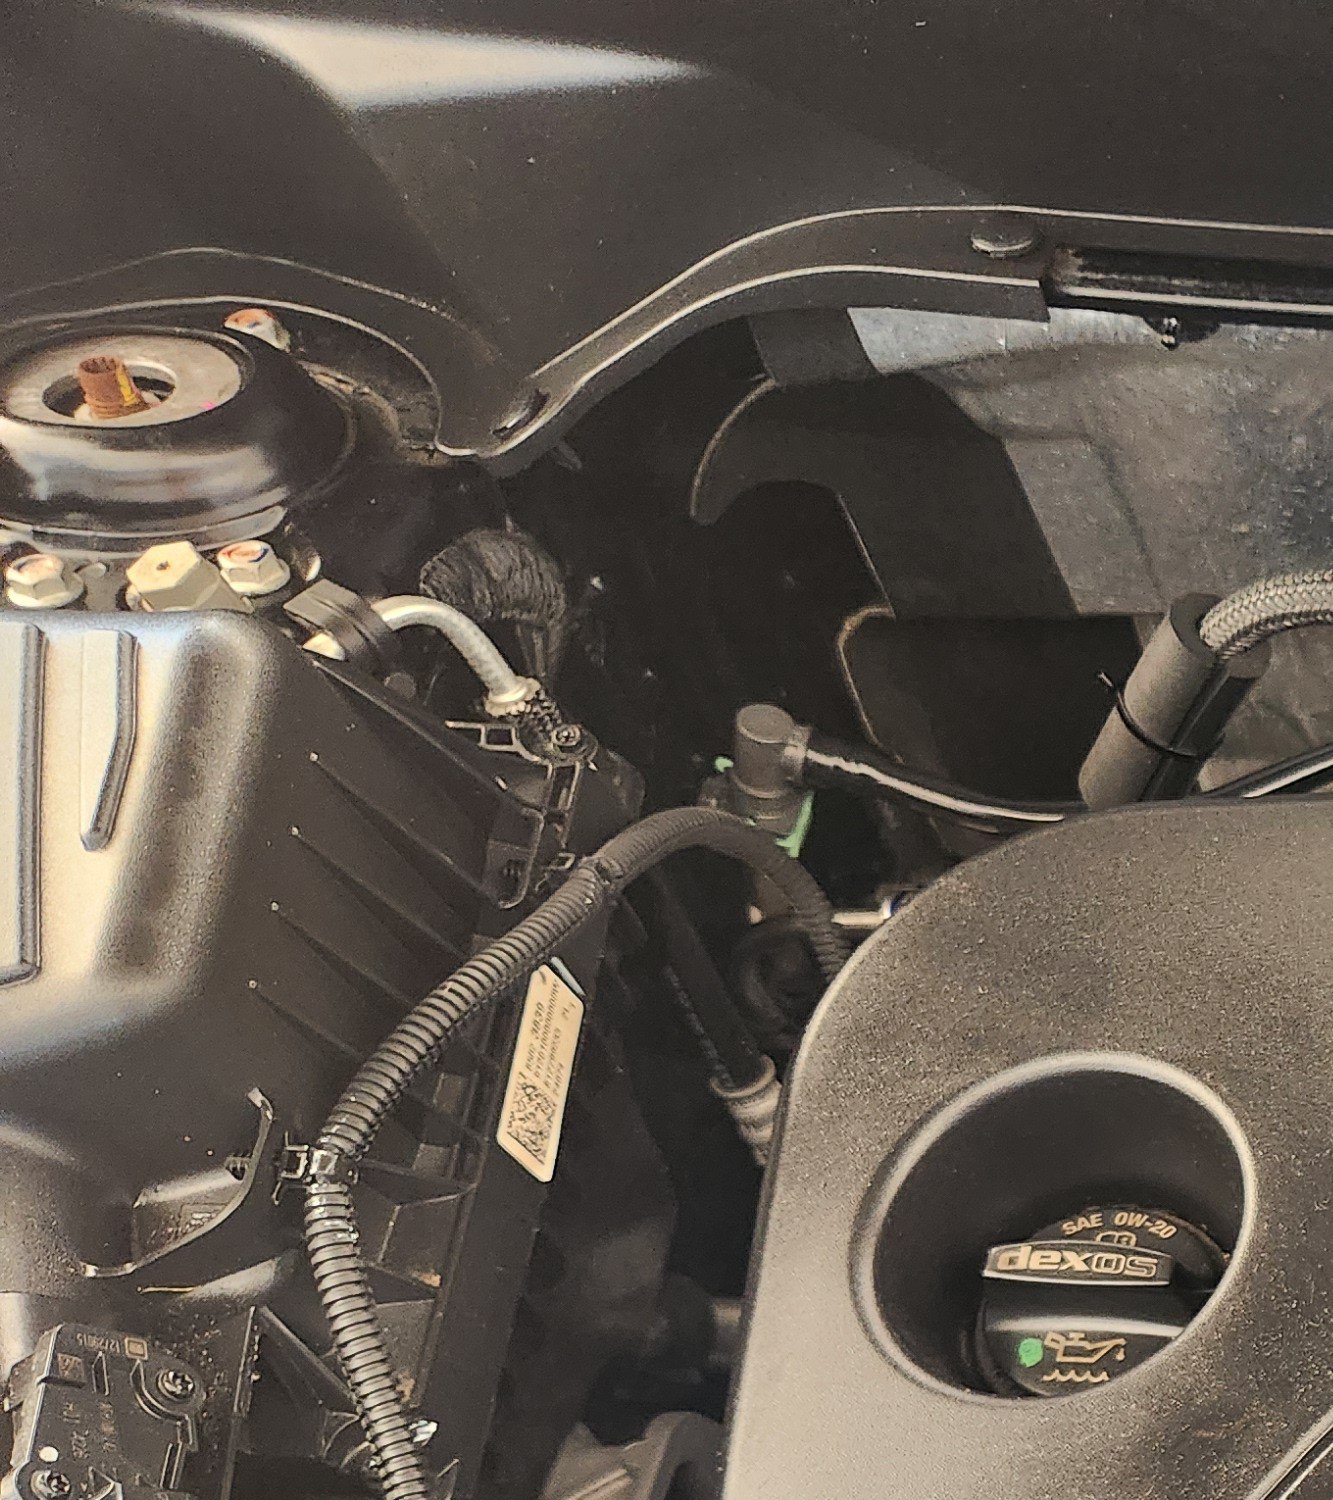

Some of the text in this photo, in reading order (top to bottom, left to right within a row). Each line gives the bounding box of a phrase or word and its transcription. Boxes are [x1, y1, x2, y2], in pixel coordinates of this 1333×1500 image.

[1062, 1211, 1178, 1239] SAE 0W-20
[997, 1246, 1158, 1277] dexos
